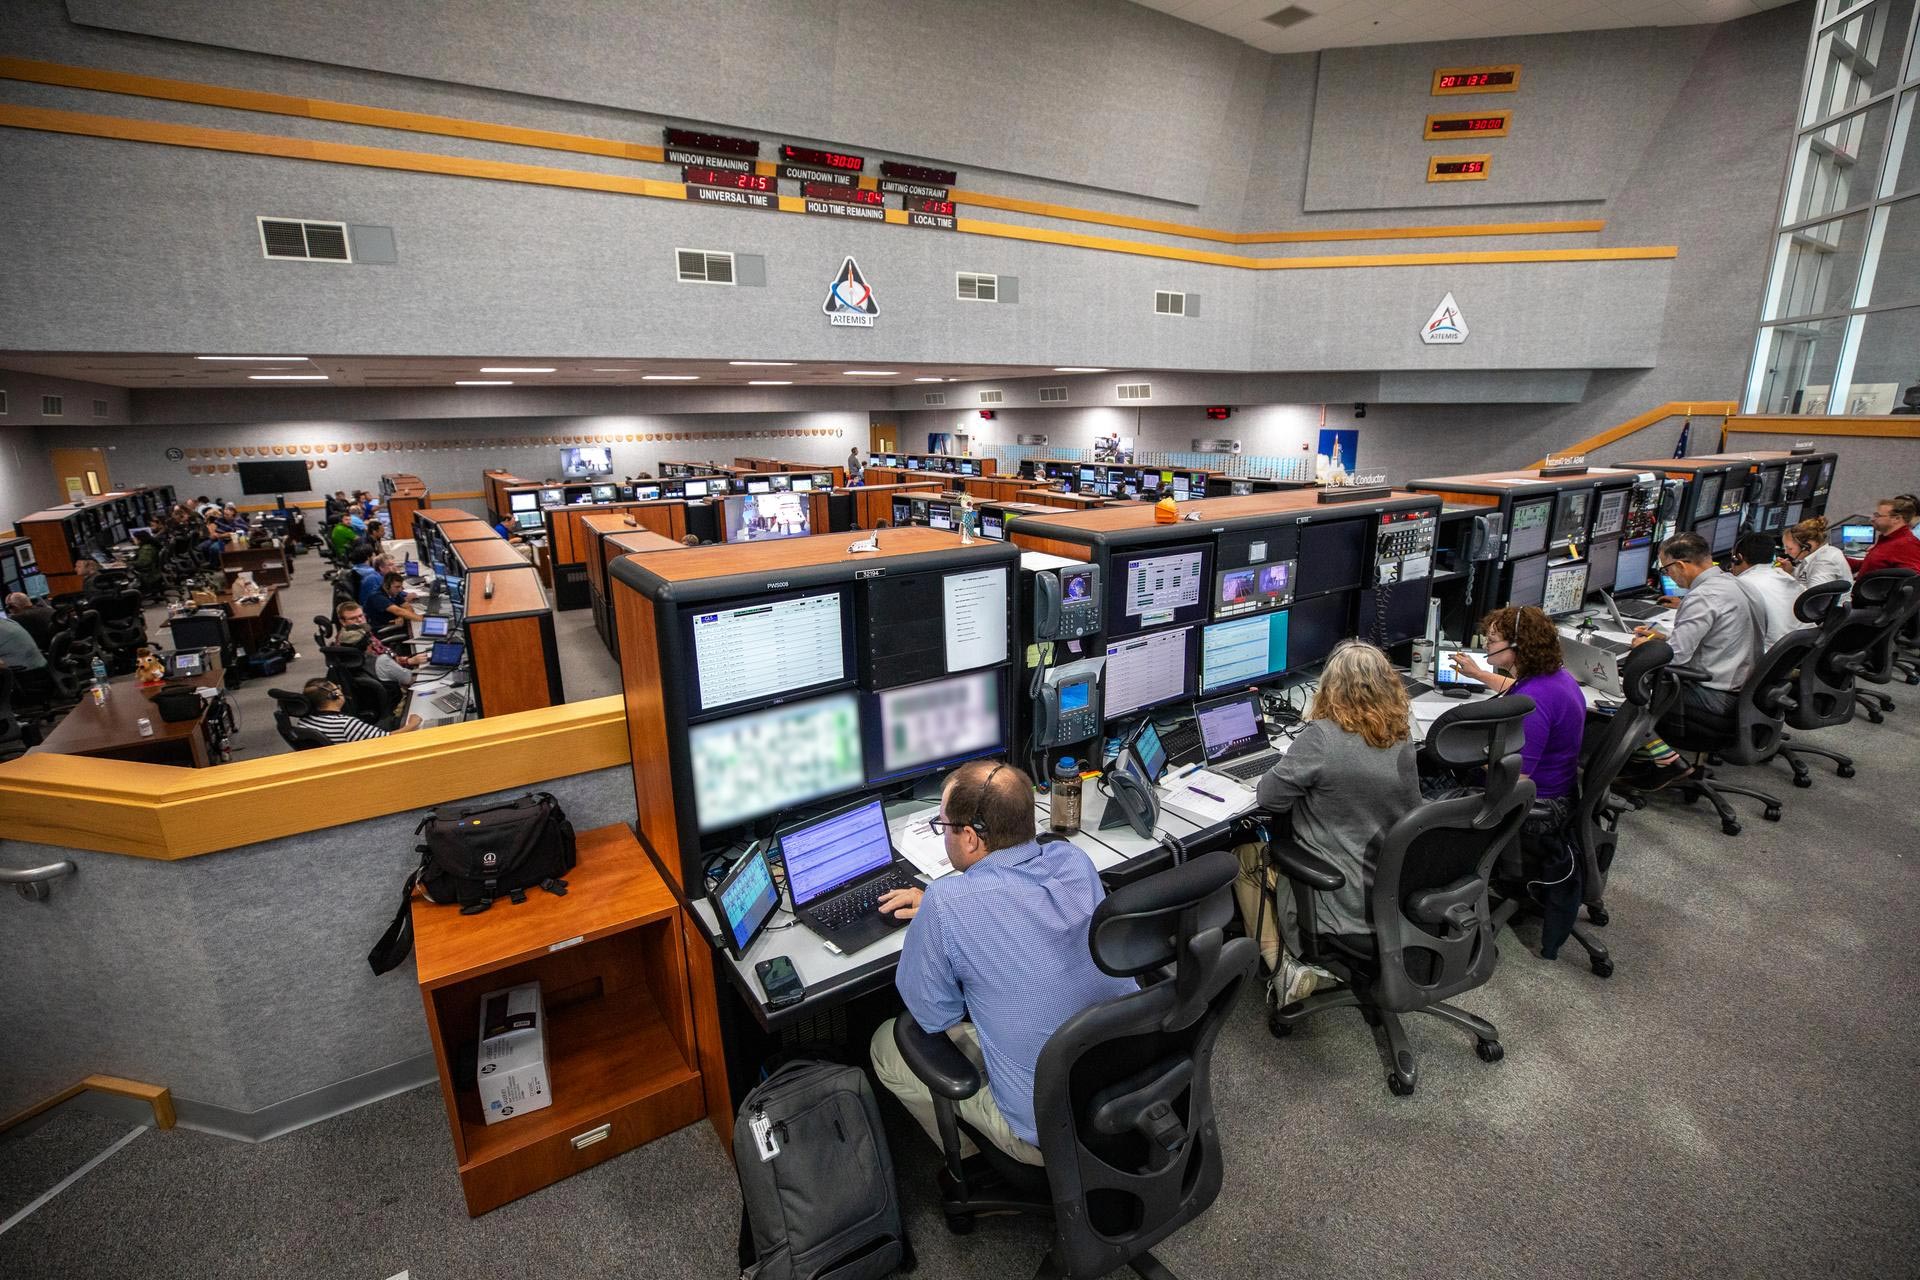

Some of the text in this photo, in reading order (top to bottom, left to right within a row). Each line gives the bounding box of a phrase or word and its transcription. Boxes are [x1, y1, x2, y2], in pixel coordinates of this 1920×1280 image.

[669, 151, 749, 171] WINDOW REMAINING
[786, 168, 850, 185] COUNTDOWN TIME
[699, 189, 768, 206] UNIVERSAL TIME
[882, 182, 947, 199] LIMITING CONSTRAINT
[808, 202, 884, 220] HOLD TIME REMAINING
[914, 215, 952, 228] LOCAL TIME
[833, 315, 866, 324] ARTEMIS
[1355, 474, 1386, 485] Conductor
